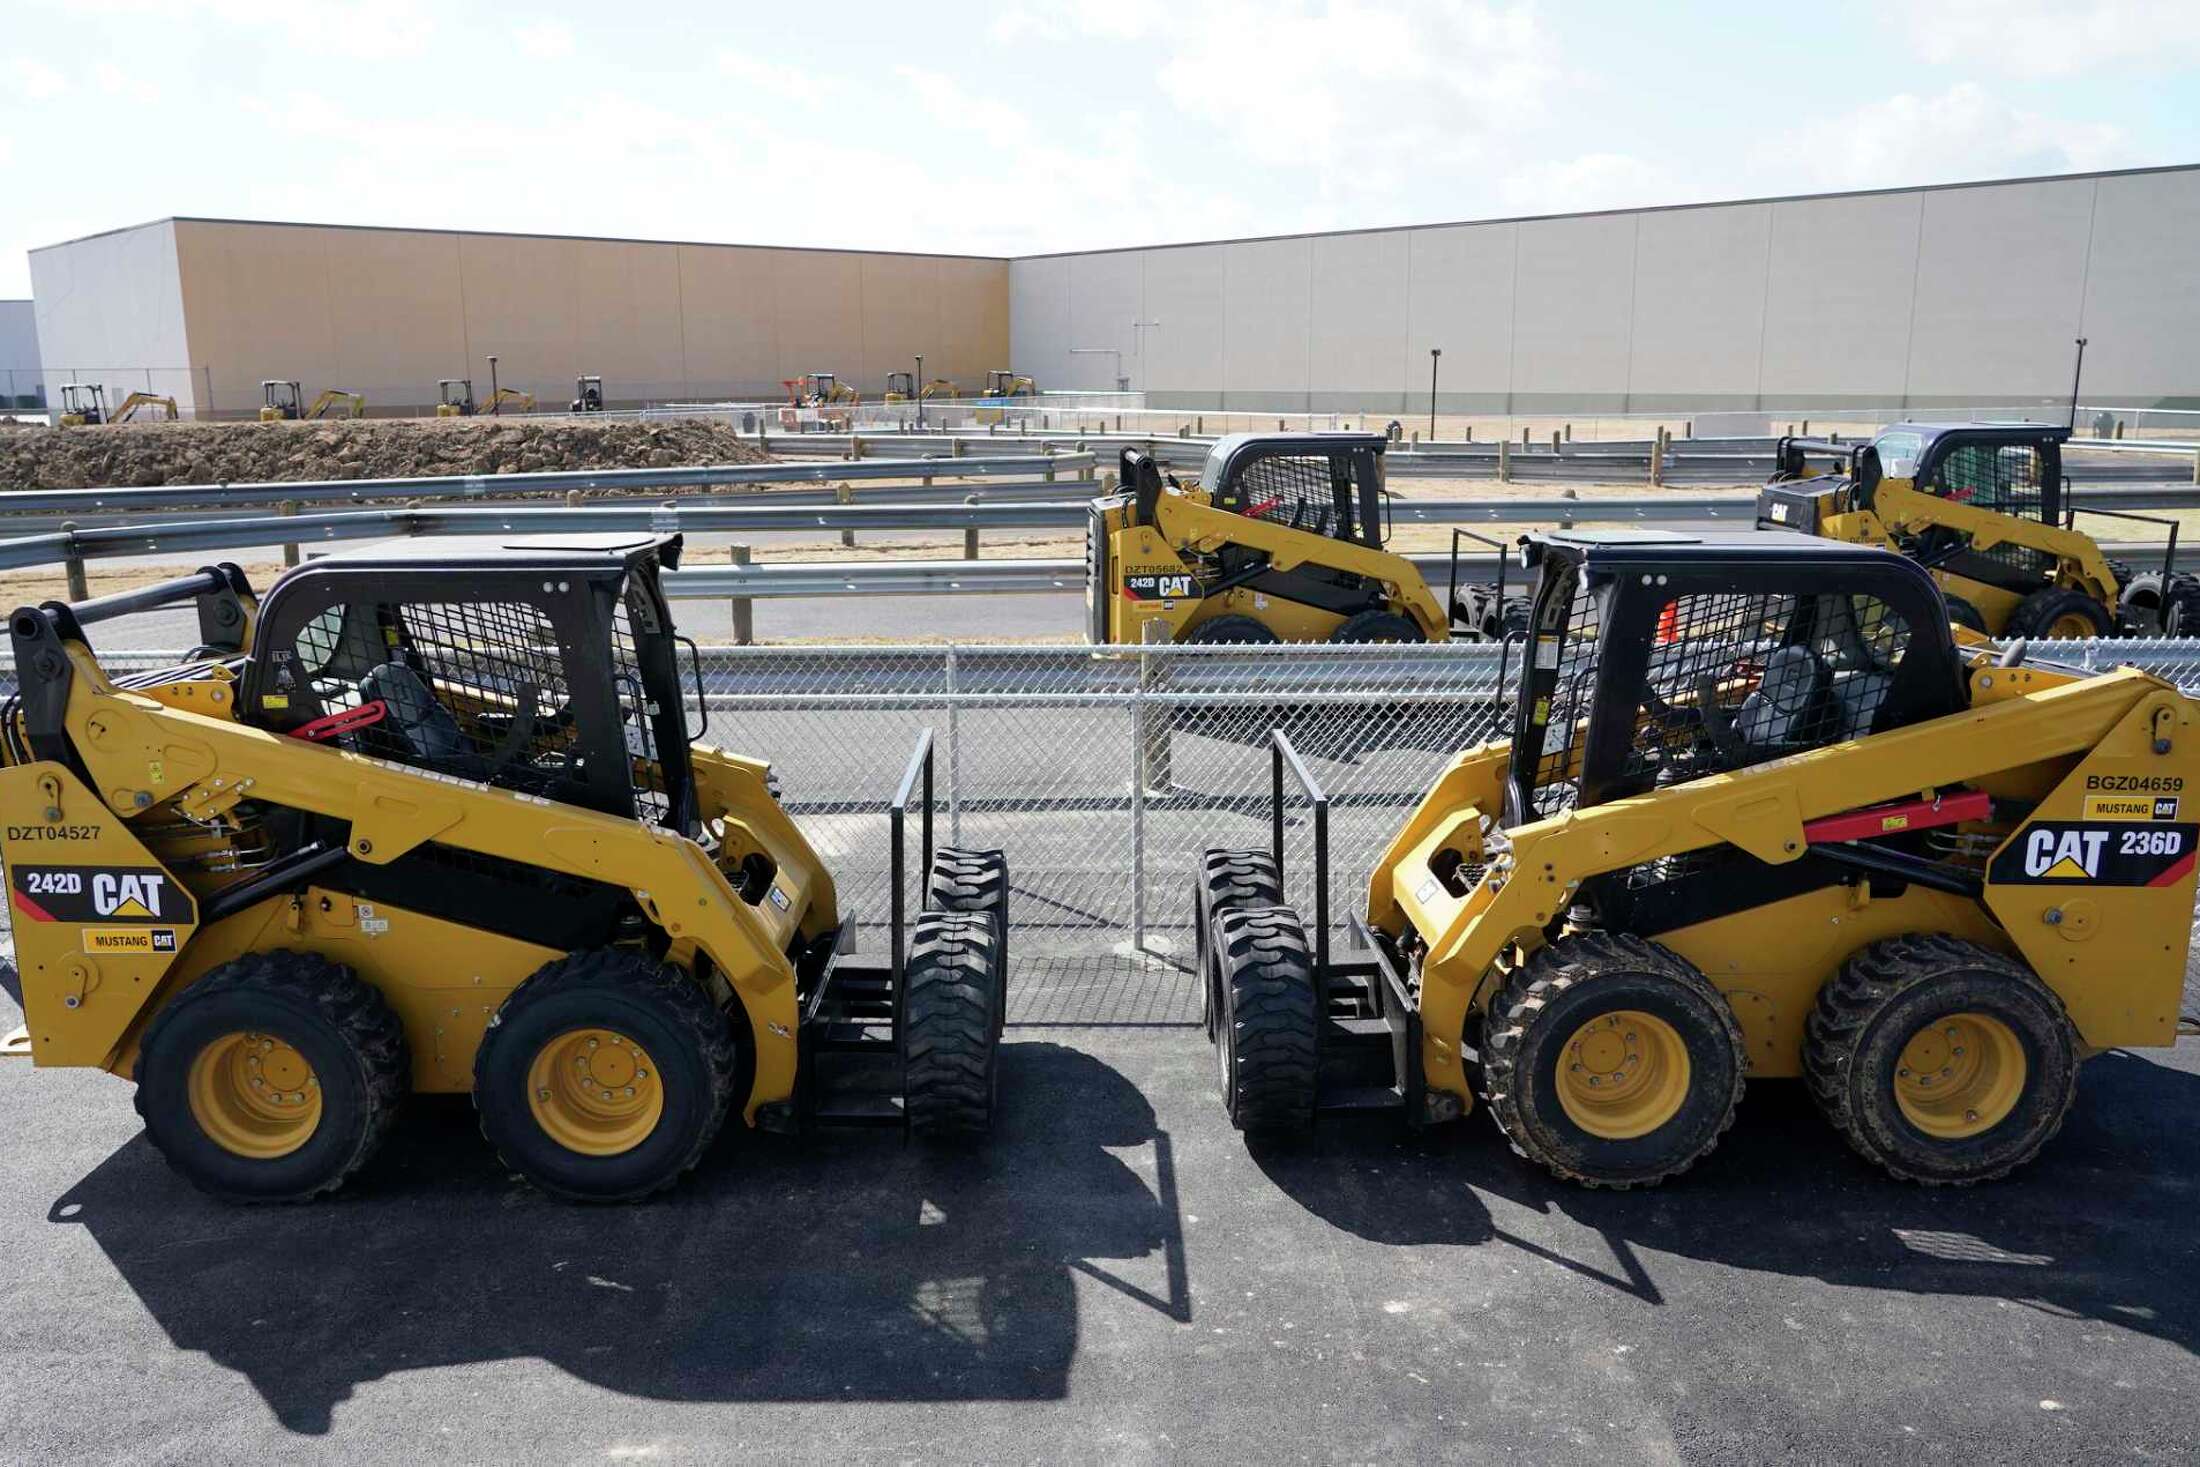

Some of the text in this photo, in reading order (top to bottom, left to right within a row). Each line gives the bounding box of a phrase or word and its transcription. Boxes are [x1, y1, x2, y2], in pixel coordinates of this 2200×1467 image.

[1130, 576, 1191, 597] 242D CAT
[2086, 775, 2183, 791] BGZ04659
[2096, 803, 2176, 815] MUSTANG CAT
[7, 826, 101, 841] DZT04527
[2025, 829, 2181, 878] CAT 236D
[27, 873, 164, 917] 242D CAT
[95, 935, 173, 947] MUSTANG CAT
